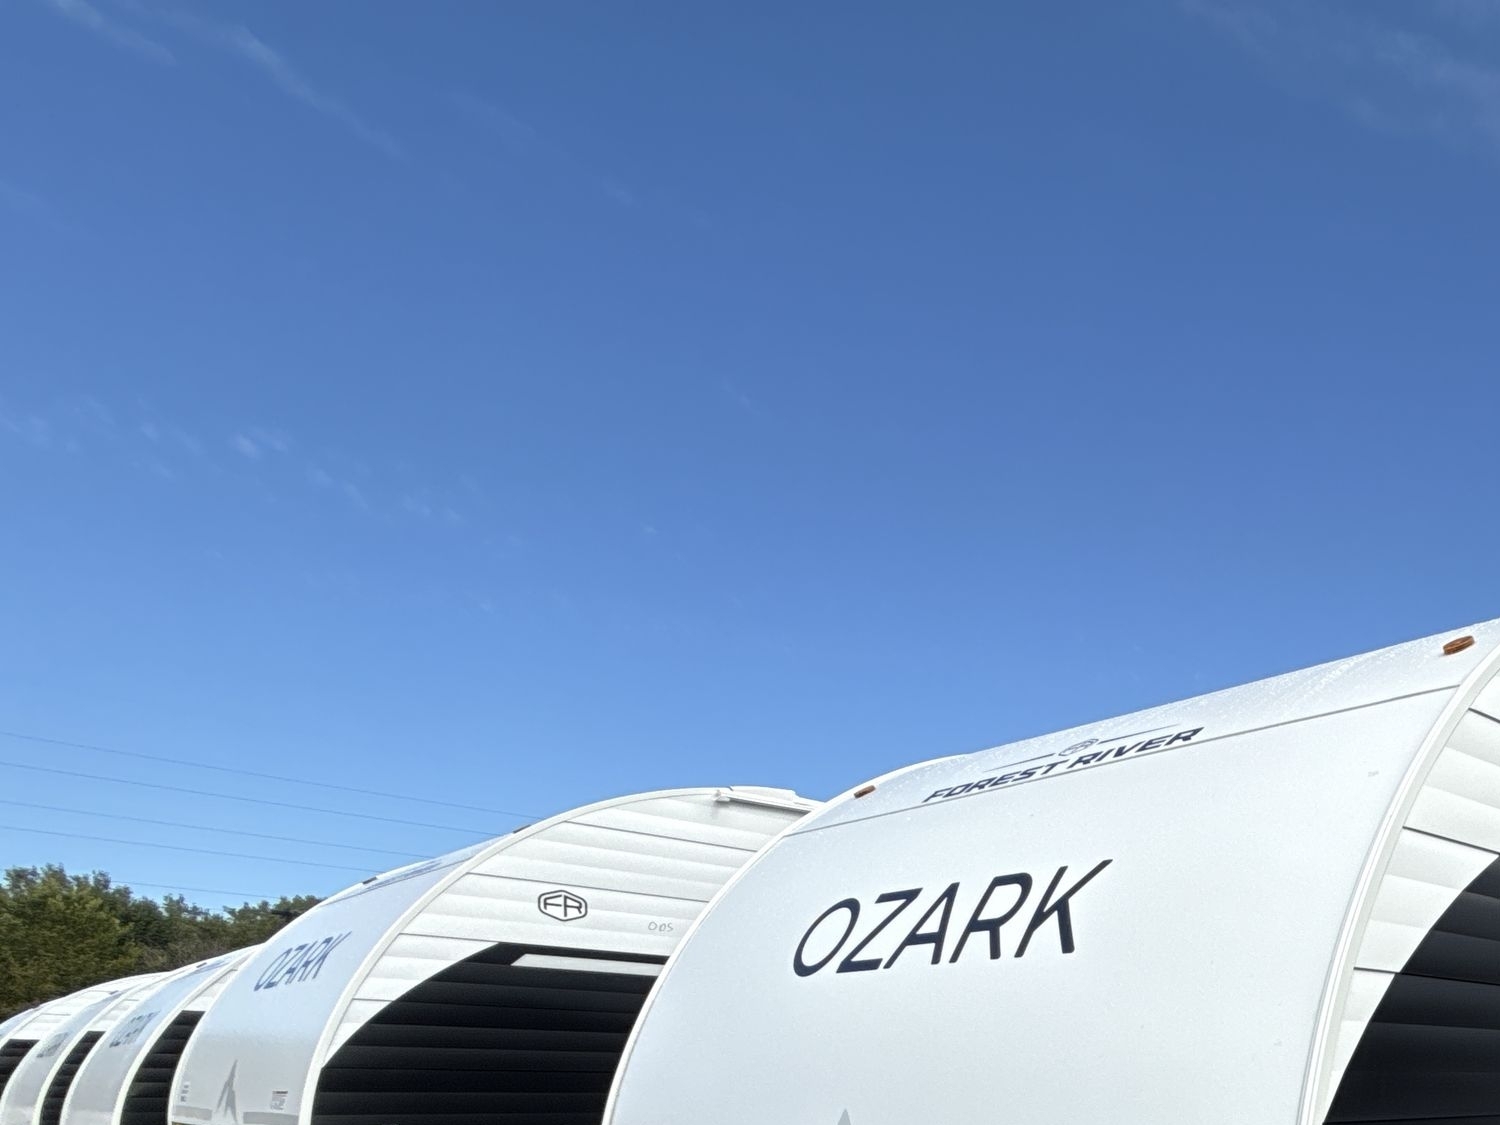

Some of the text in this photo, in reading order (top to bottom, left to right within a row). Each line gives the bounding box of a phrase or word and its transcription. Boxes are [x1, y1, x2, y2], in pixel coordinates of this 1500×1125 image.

[921, 759, 1070, 803] FOREST
[1066, 727, 1205, 770] RIVER
[793, 859, 1114, 978] OZARK
[254, 931, 352, 991] OZARK
